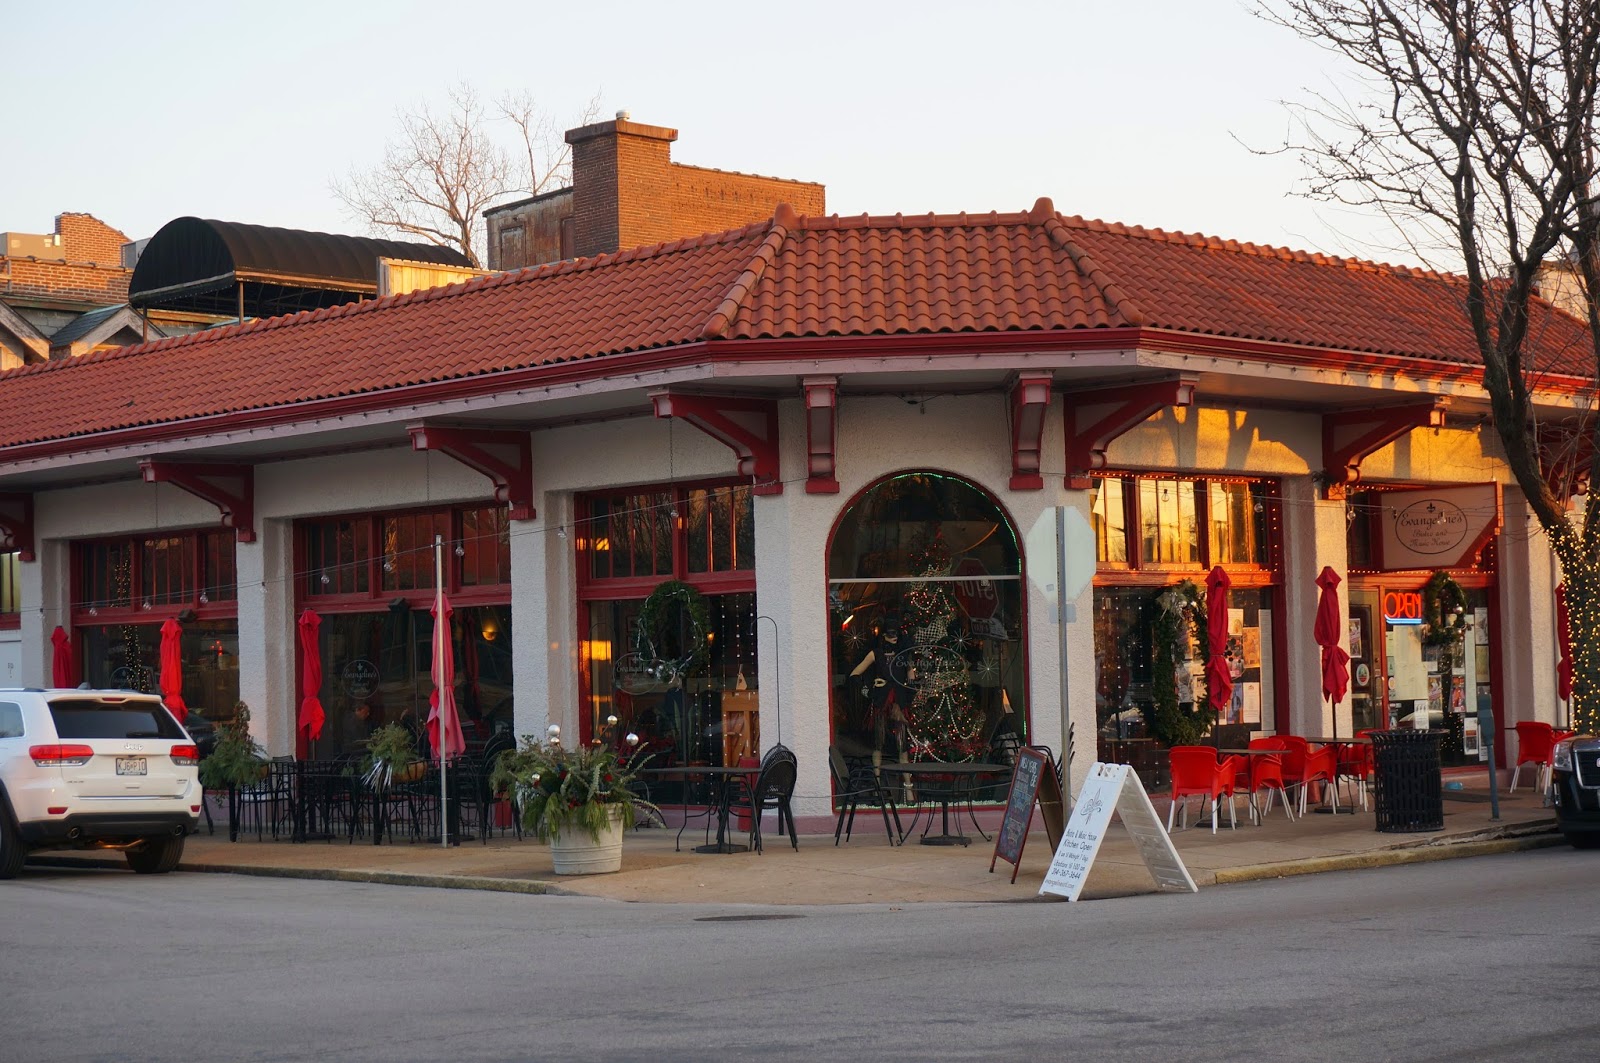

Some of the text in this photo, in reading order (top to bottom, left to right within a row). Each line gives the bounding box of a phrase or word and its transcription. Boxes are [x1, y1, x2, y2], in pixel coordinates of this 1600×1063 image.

[1401, 511, 1462, 530] Evangene's
[1412, 528, 1448, 537] Bistro and
[1384, 592, 1422, 618] OPEN
[124, 743, 143, 751] Jeep
[1063, 839, 1092, 853] Kitchen Open
